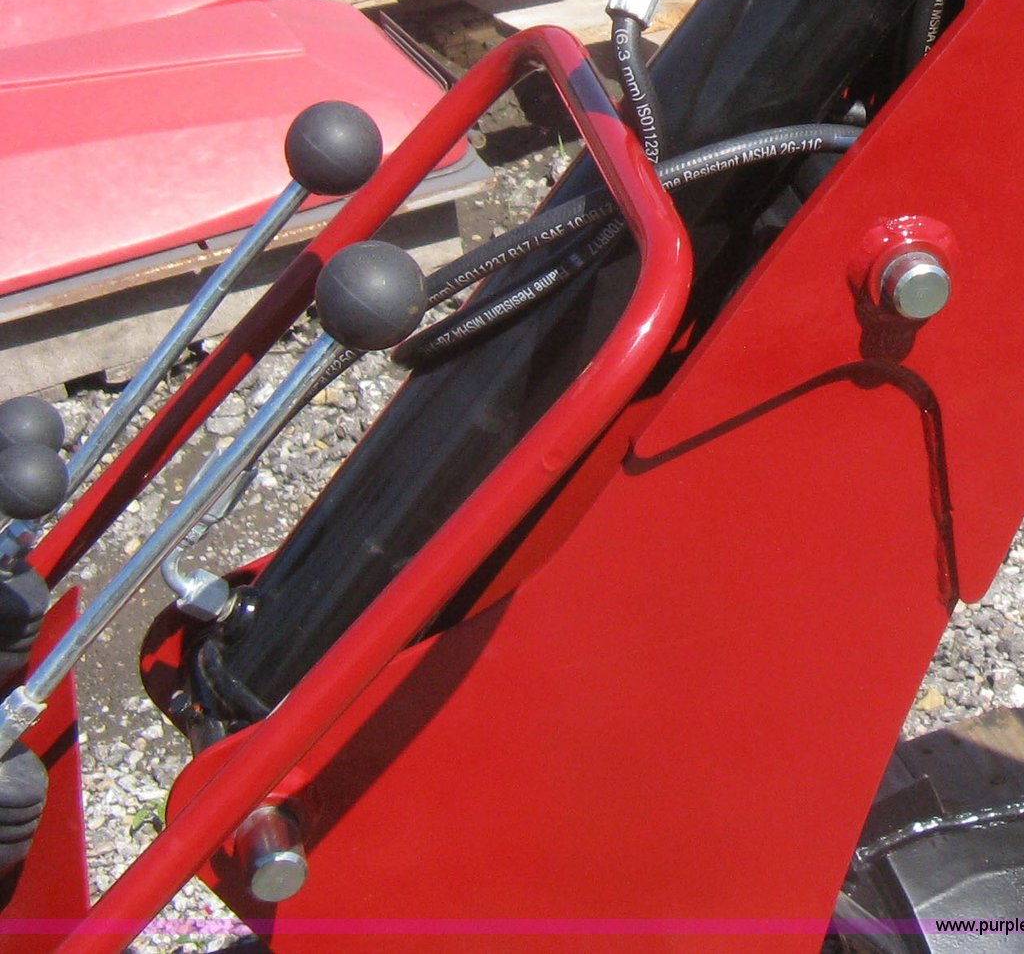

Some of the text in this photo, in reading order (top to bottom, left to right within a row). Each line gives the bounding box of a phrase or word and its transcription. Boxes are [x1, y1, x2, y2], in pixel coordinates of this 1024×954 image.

[926, 6, 945, 43] MSHA
[615, 28, 659, 164] (6.3 mm) ISO11237
[683, 154, 740, 184] Resistant
[742, 144, 777, 164] MSHA
[780, 137, 822, 155] 2G-11C
[483, 286, 537, 322] Resistant
[451, 315, 487, 340] MSHA
